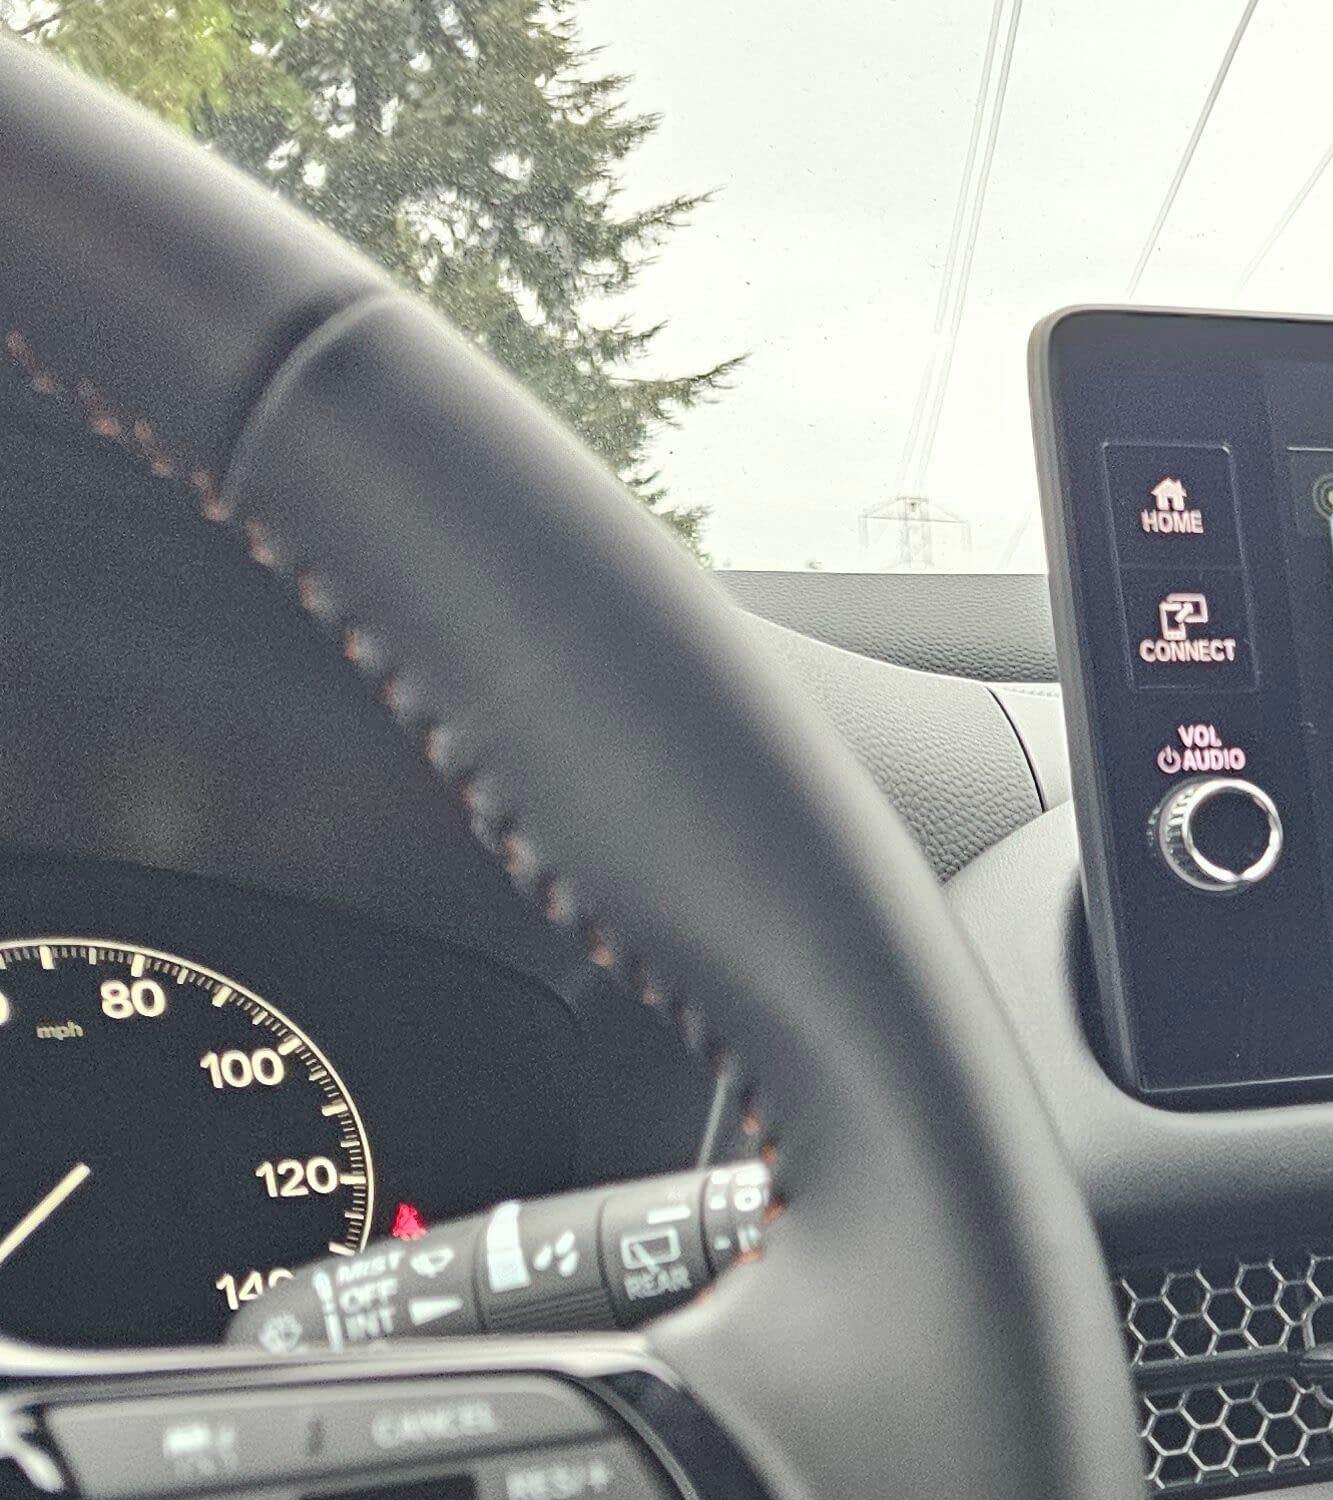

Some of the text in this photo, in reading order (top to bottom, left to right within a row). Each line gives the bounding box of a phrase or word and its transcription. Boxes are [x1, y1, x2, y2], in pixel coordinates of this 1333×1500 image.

[1141, 509, 1204, 533] HOME
[1139, 638, 1236, 663] CONNECT
[1178, 725, 1221, 748] VOL
[1182, 746, 1246, 771] AUDIO
[100, 979, 167, 1019] 80
[37, 1019, 84, 1040] mph
[200, 1047, 284, 1090] 100
[256, 1155, 339, 1199] 120
[339, 1277, 398, 1313] OFF
[624, 1264, 691, 1300] REAR
